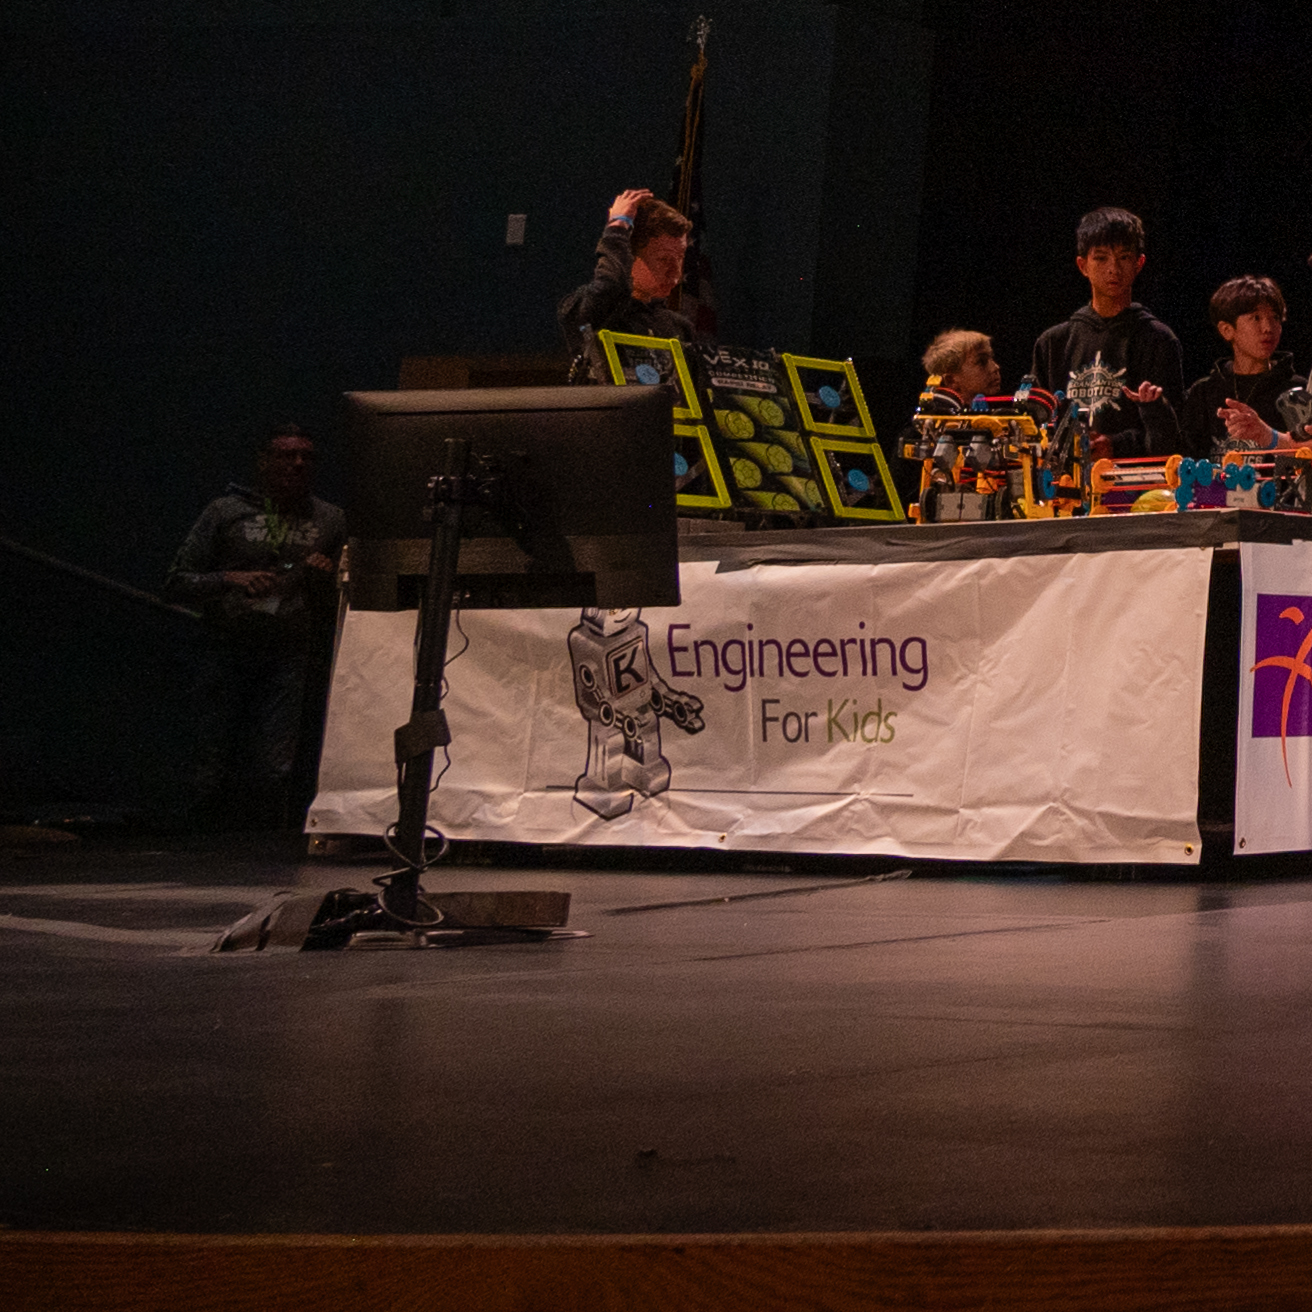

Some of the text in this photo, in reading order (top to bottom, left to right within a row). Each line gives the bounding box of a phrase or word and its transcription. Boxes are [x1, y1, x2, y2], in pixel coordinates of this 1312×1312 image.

[667, 621, 930, 692] Engineering
[760, 698, 897, 745] For Kids
